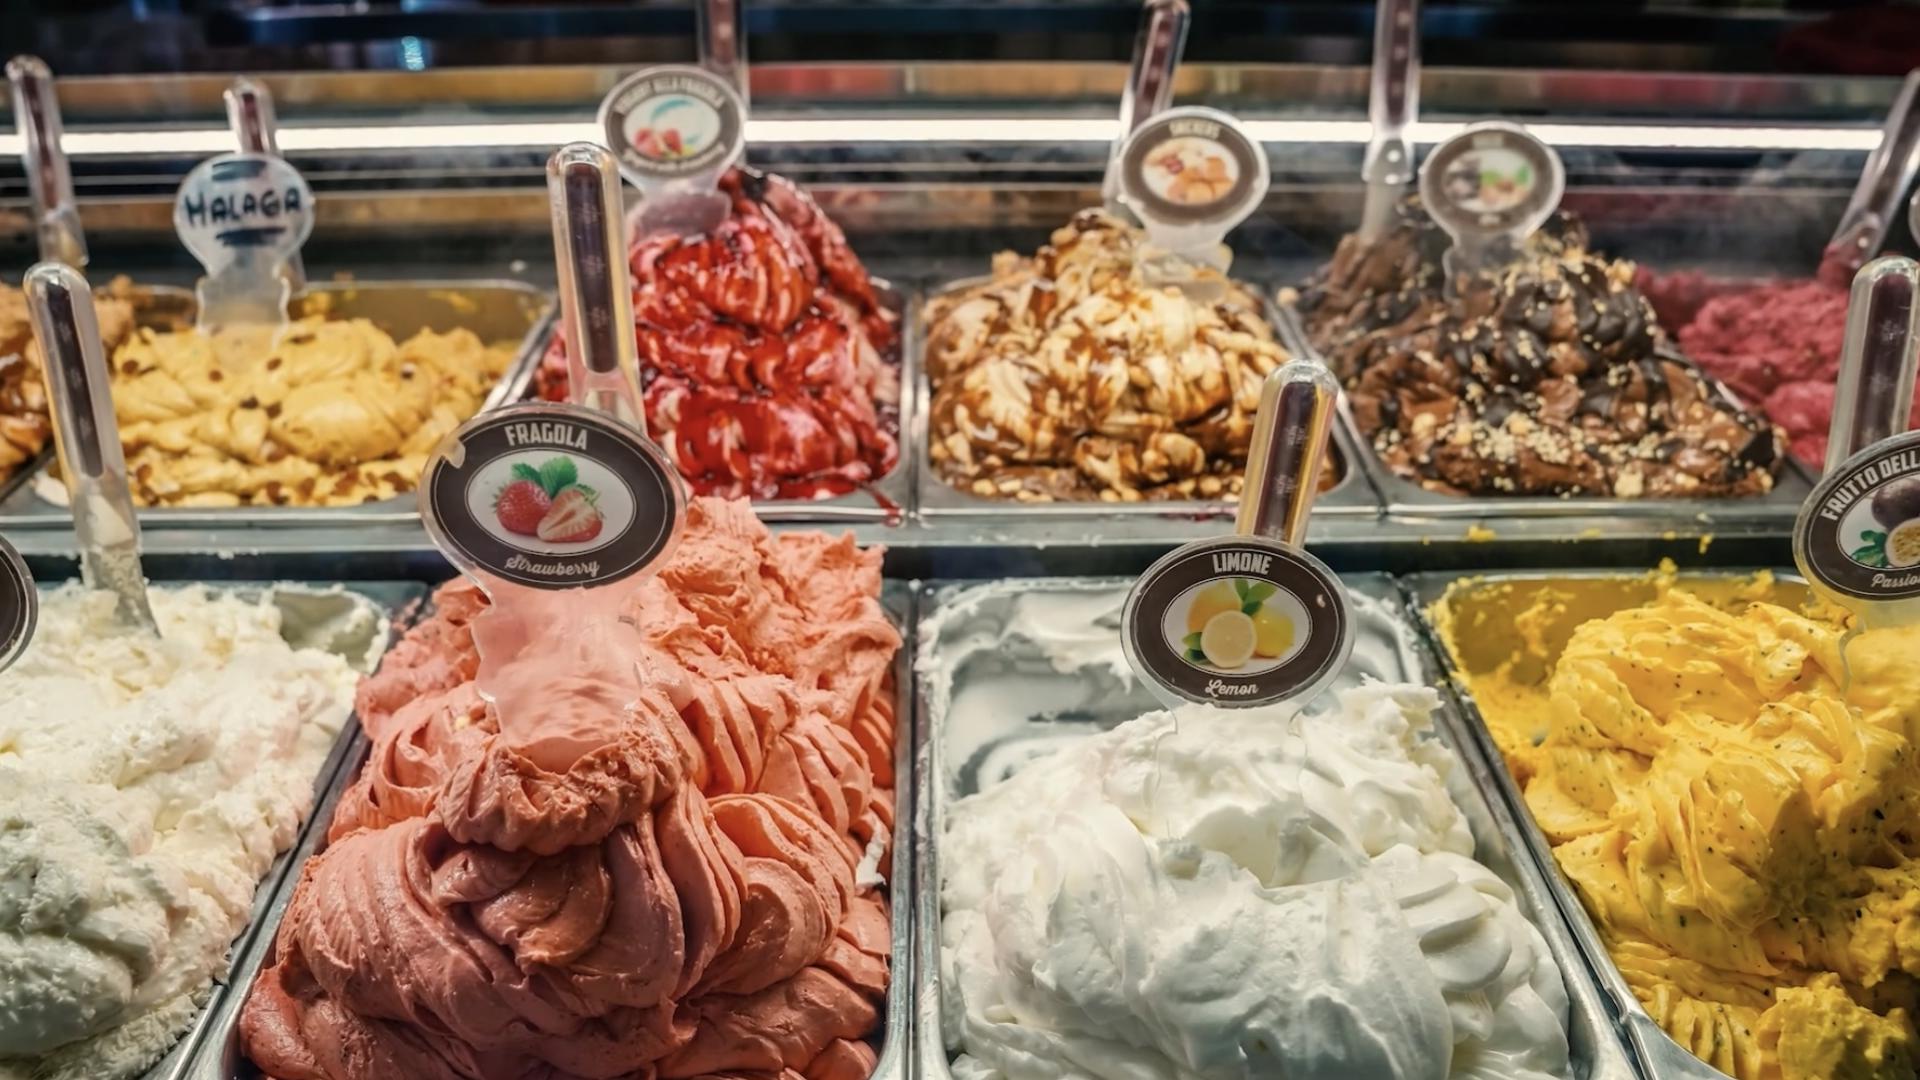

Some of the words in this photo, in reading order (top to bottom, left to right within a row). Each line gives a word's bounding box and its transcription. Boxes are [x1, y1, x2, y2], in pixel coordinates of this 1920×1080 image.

[504, 422, 588, 450] FRAGOLA
[1820, 466, 1880, 521] FRUTTO
[1878, 450, 1920, 475] DELL
[504, 554, 600, 577] Strawberry
[1212, 552, 1273, 575] LIMONE
[1204, 679, 1259, 697] Lemon
